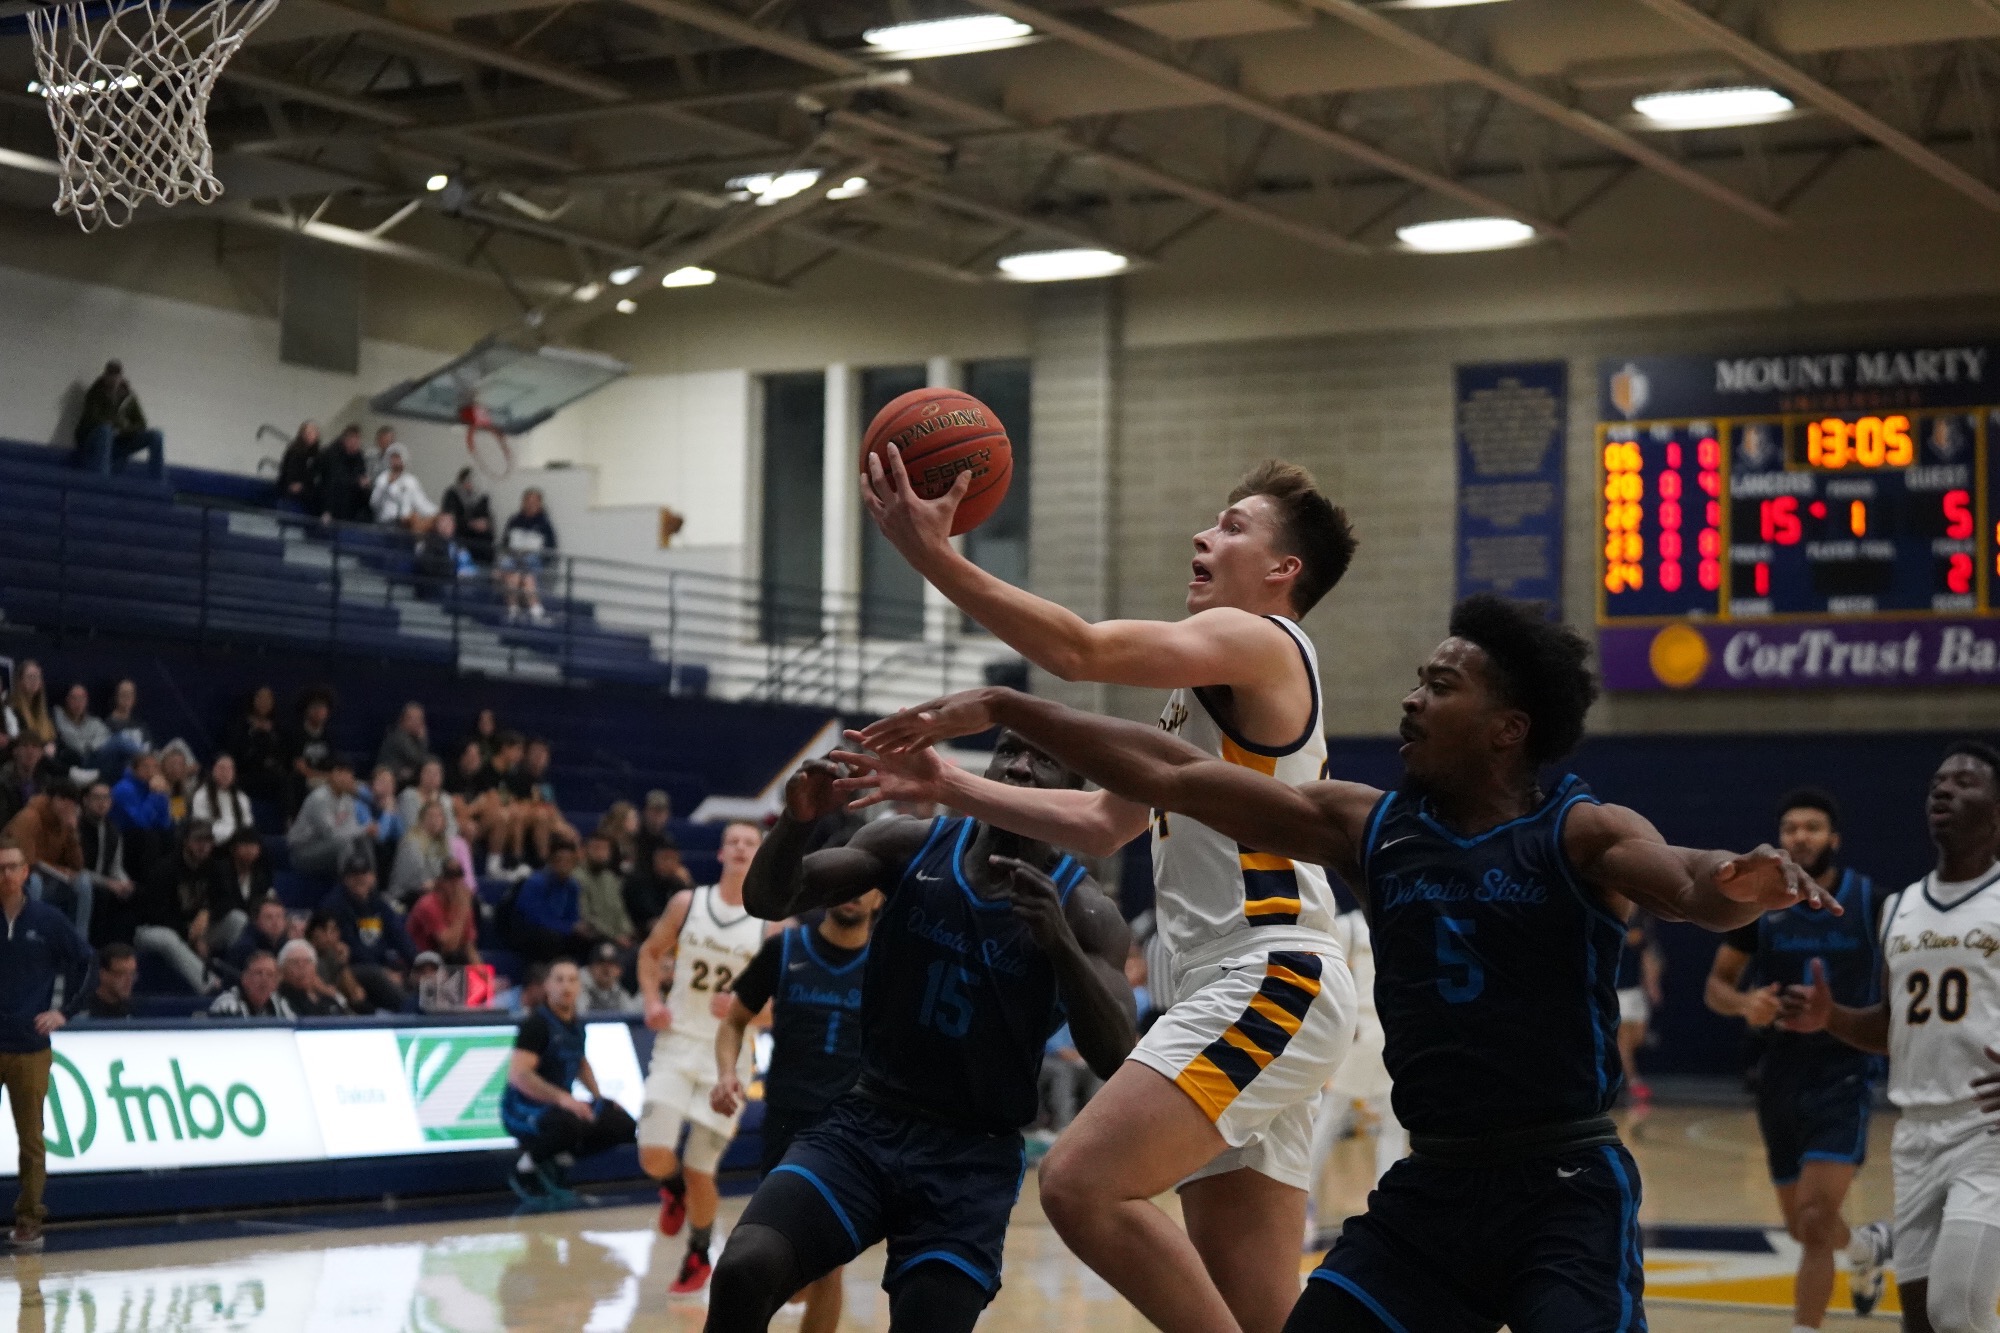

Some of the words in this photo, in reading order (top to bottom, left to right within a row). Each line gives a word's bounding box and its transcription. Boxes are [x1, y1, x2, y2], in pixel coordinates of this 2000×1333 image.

[1716, 355, 1848, 392] MOUNT
[1856, 349, 1984, 384] MARTY
[1808, 415, 1913, 468] 13:05
[911, 447, 991, 486] LEGACY
[1760, 495, 1802, 545] 15
[1850, 500, 1866, 537] 1
[1943, 489, 1974, 540] 5
[1755, 562, 1770, 596] 1
[1947, 552, 1974, 593] 2
[1723, 630, 1921, 679] CorTrust
[1937, 626, 2000, 673] Ba
[1474, 868, 1547, 904] State
[691, 959, 732, 993] 22
[1435, 916, 1484, 1004] 5
[917, 959, 981, 1039] 15
[1907, 967, 1968, 1025] 20
[825, 1011, 842, 1054] 1
[106, 1057, 266, 1142] fnbo
